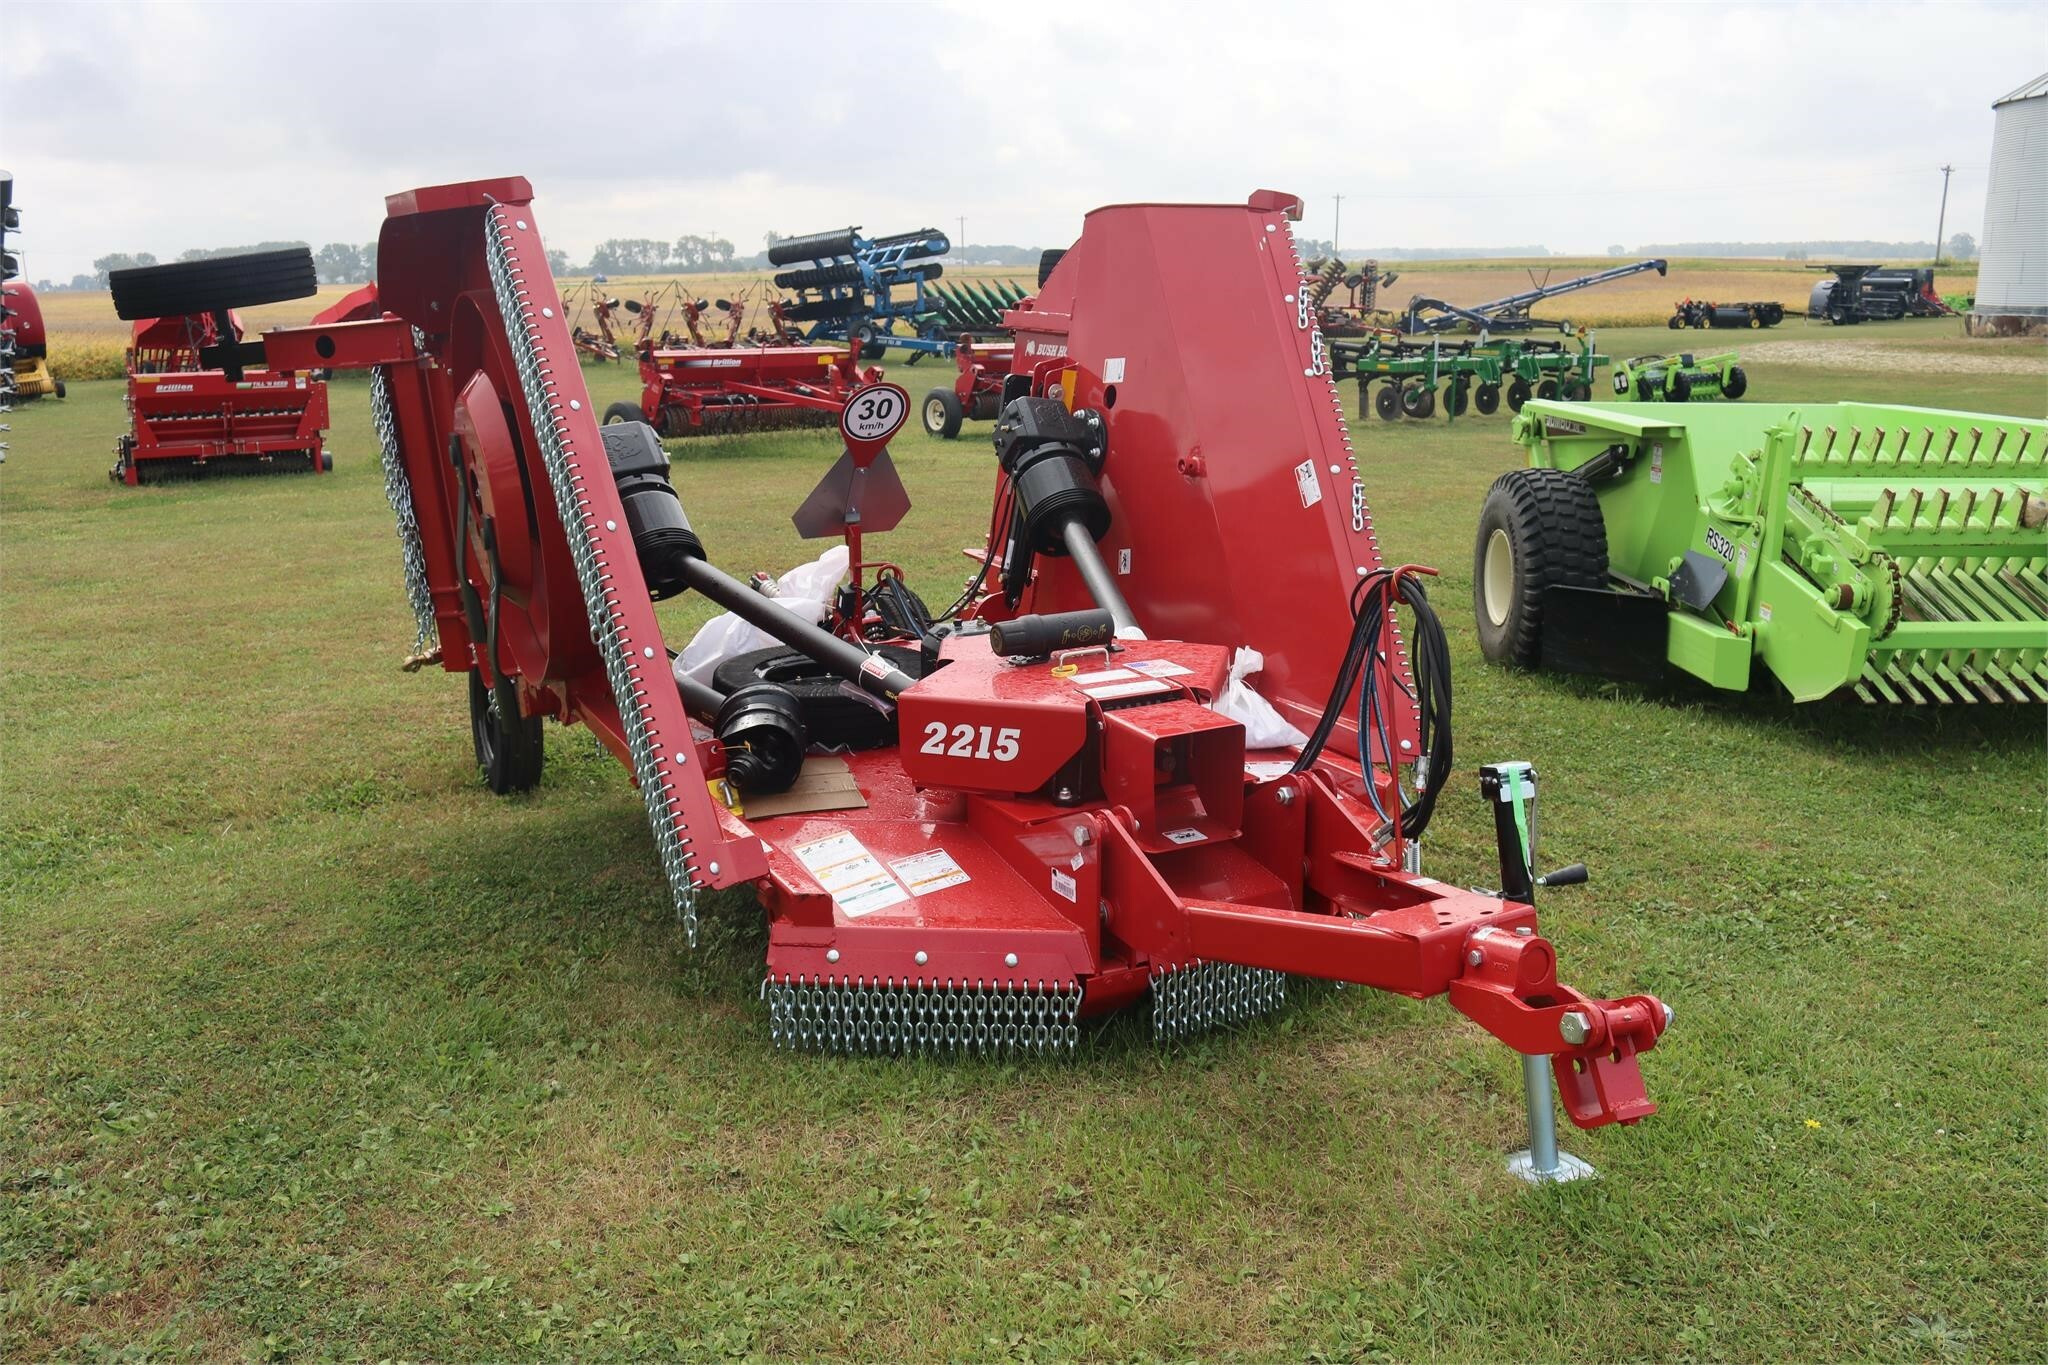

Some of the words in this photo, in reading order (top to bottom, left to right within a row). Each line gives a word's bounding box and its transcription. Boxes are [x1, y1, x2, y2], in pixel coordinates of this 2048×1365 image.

[1037, 344, 1058, 356] BUSH
[712, 359, 742, 367] Brillion
[156, 384, 194, 392] Brillion
[858, 398, 893, 421] 30
[858, 422, 884, 431] km/h
[1705, 527, 1735, 562] RS320
[920, 721, 1021, 762] 2215
